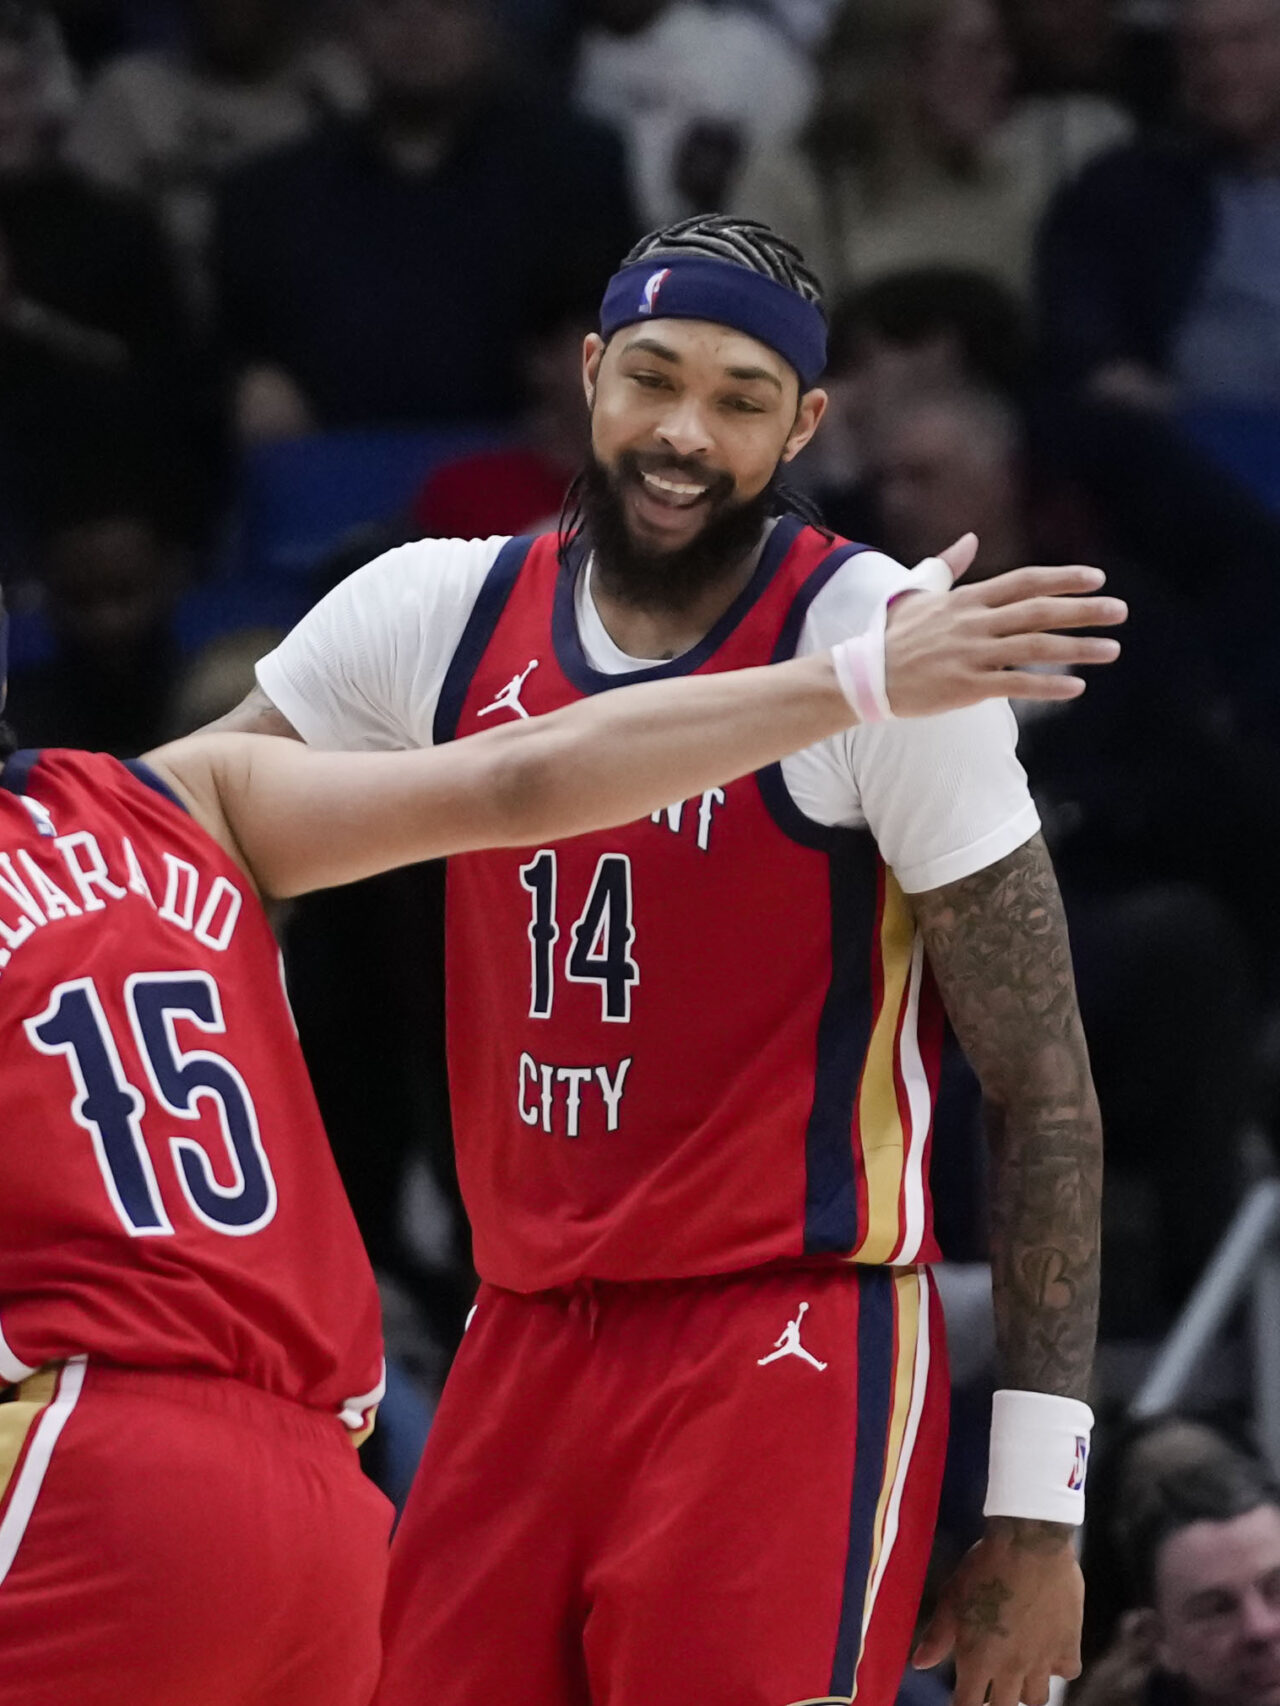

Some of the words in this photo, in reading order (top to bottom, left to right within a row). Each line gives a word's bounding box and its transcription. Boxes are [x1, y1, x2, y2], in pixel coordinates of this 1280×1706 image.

[519, 849, 640, 1023] 14
[23, 970, 278, 1237] 15
[518, 1051, 632, 1137] CITY
